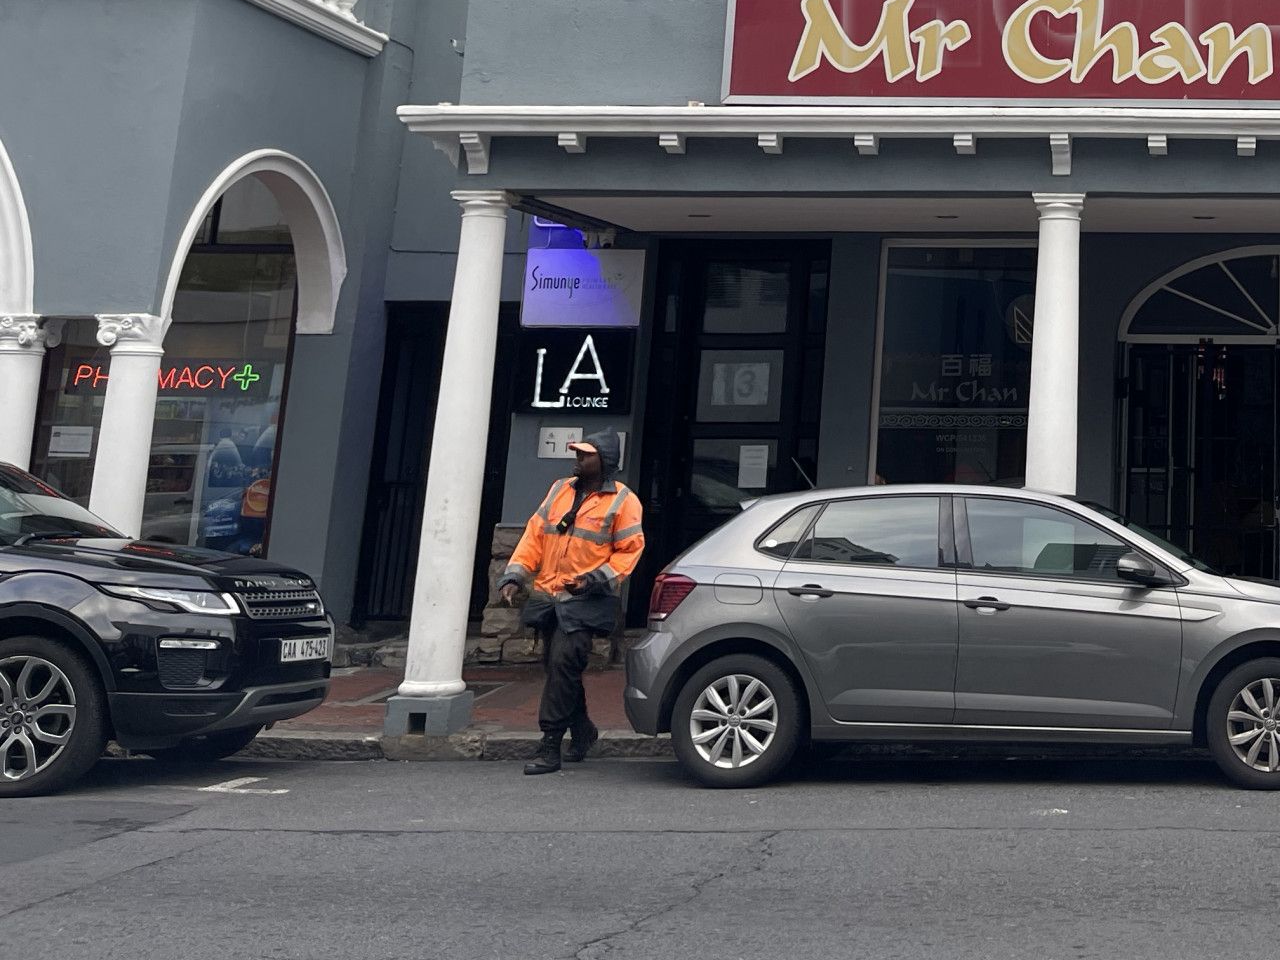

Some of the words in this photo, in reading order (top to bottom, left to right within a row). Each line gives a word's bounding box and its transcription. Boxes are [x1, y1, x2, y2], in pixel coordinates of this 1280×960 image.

[531, 265, 580, 298] Simunye
[74, 365, 235, 389] PHMACY
[531, 334, 610, 408] LA
[567, 397, 608, 408] LOUNGE
[911, 381, 949, 401] Mr
[956, 380, 1018, 402] Chan
[283, 642, 297, 659] CAA
[301, 639, 326, 657] 475-423
